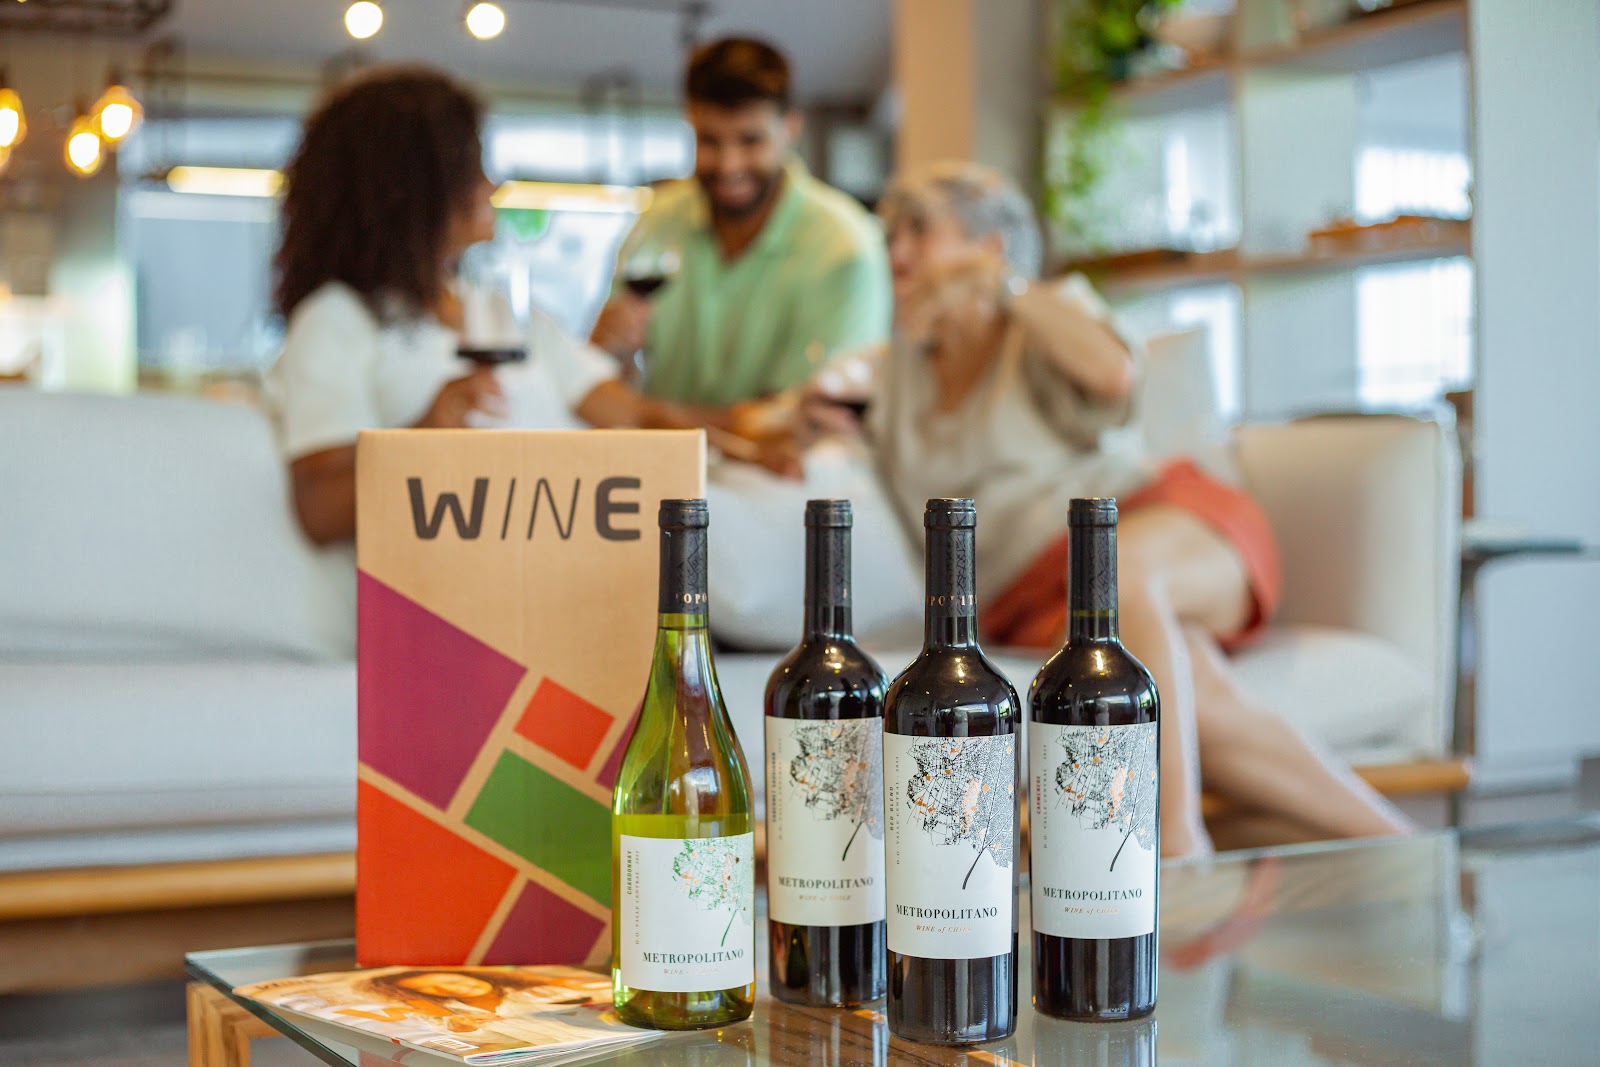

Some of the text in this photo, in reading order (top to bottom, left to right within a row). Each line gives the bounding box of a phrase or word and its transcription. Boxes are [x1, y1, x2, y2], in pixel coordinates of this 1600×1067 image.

[407, 476, 641, 541] WINE
[778, 875, 874, 889] METROPOLITANO
[1043, 886, 1142, 901] METROPOLITANO
[896, 904, 997, 919] METROPOLITANO
[1064, 906, 1083, 914] WINE
[916, 924, 935, 932] WINE
[642, 949, 744, 964] METROPOLITANO
